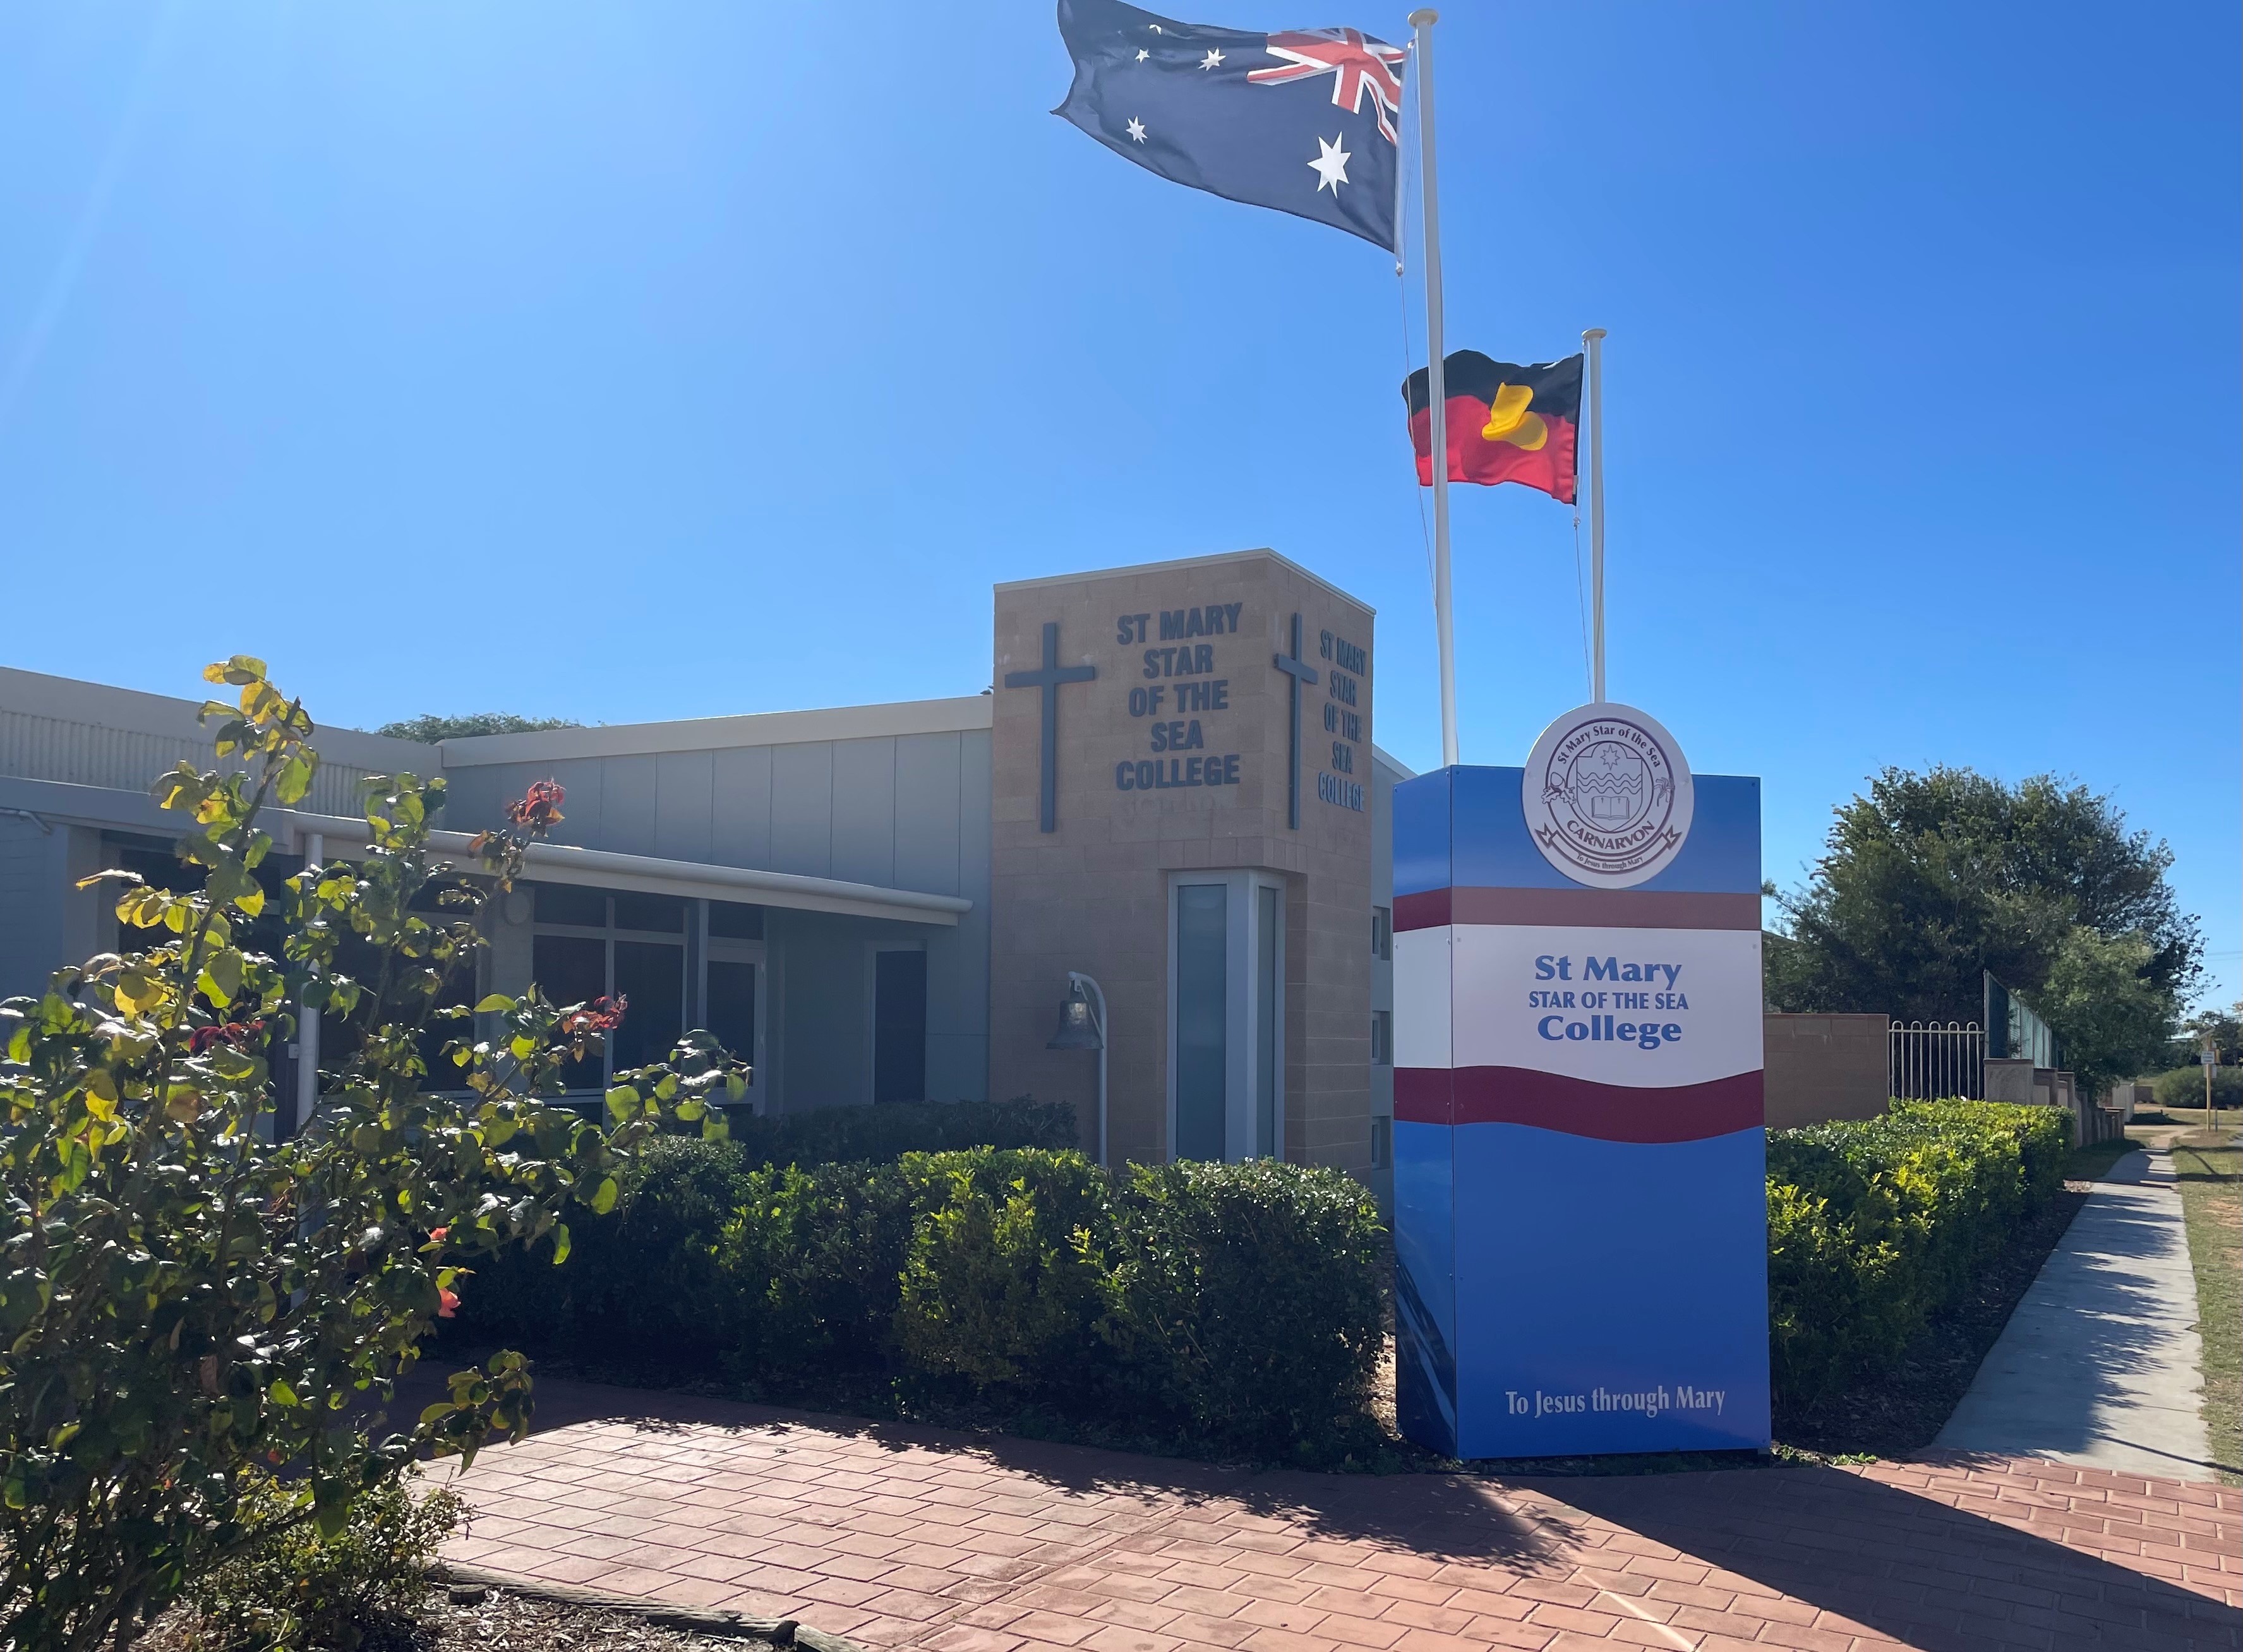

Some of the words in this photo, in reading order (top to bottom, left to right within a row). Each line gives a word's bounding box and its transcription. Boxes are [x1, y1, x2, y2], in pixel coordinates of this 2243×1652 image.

[1117, 614, 1150, 645] ST
[1159, 602, 1242, 641] MARY
[1143, 645, 1213, 678] STAR
[1320, 630, 1334, 661] ST
[1337, 637, 1366, 676] MARY
[1128, 685, 1164, 717] OF
[1173, 680, 1228, 713] THE
[1330, 670, 1356, 707] STAR
[1151, 719, 1203, 752] SEA
[1325, 702, 1338, 732] OF
[1342, 709, 1362, 743] THE
[1332, 741, 1353, 774] SEA
[1558, 751, 1570, 765] St
[1566, 731, 1591, 751] Mary
[1593, 726, 1615, 736] Star
[1618, 728, 1630, 737] of
[1631, 733, 1647, 749] the
[1646, 747, 1661, 767] Sea
[1116, 755, 1240, 791] COLLEGE
[1318, 771, 1364, 813] COLLEGE
[1567, 820, 1655, 850] CARNARVON
[1584, 858, 1601, 868] Jesus
[1627, 856, 1643, 865] Mary
[1535, 955, 1572, 981] St
[1583, 956, 1682, 990] Mary
[1529, 991, 1576, 1008] STAR
[1581, 991, 1608, 1009] OF
[1611, 992, 1649, 1009] THE
[1655, 993, 1689, 1010] SEA
[1537, 1015, 1682, 1050] College
[1506, 1391, 1529, 1414] To
[1534, 1391, 1585, 1418] Jesus
[1592, 1386, 1669, 1418] through
[1676, 1386, 1726, 1415] Mary
